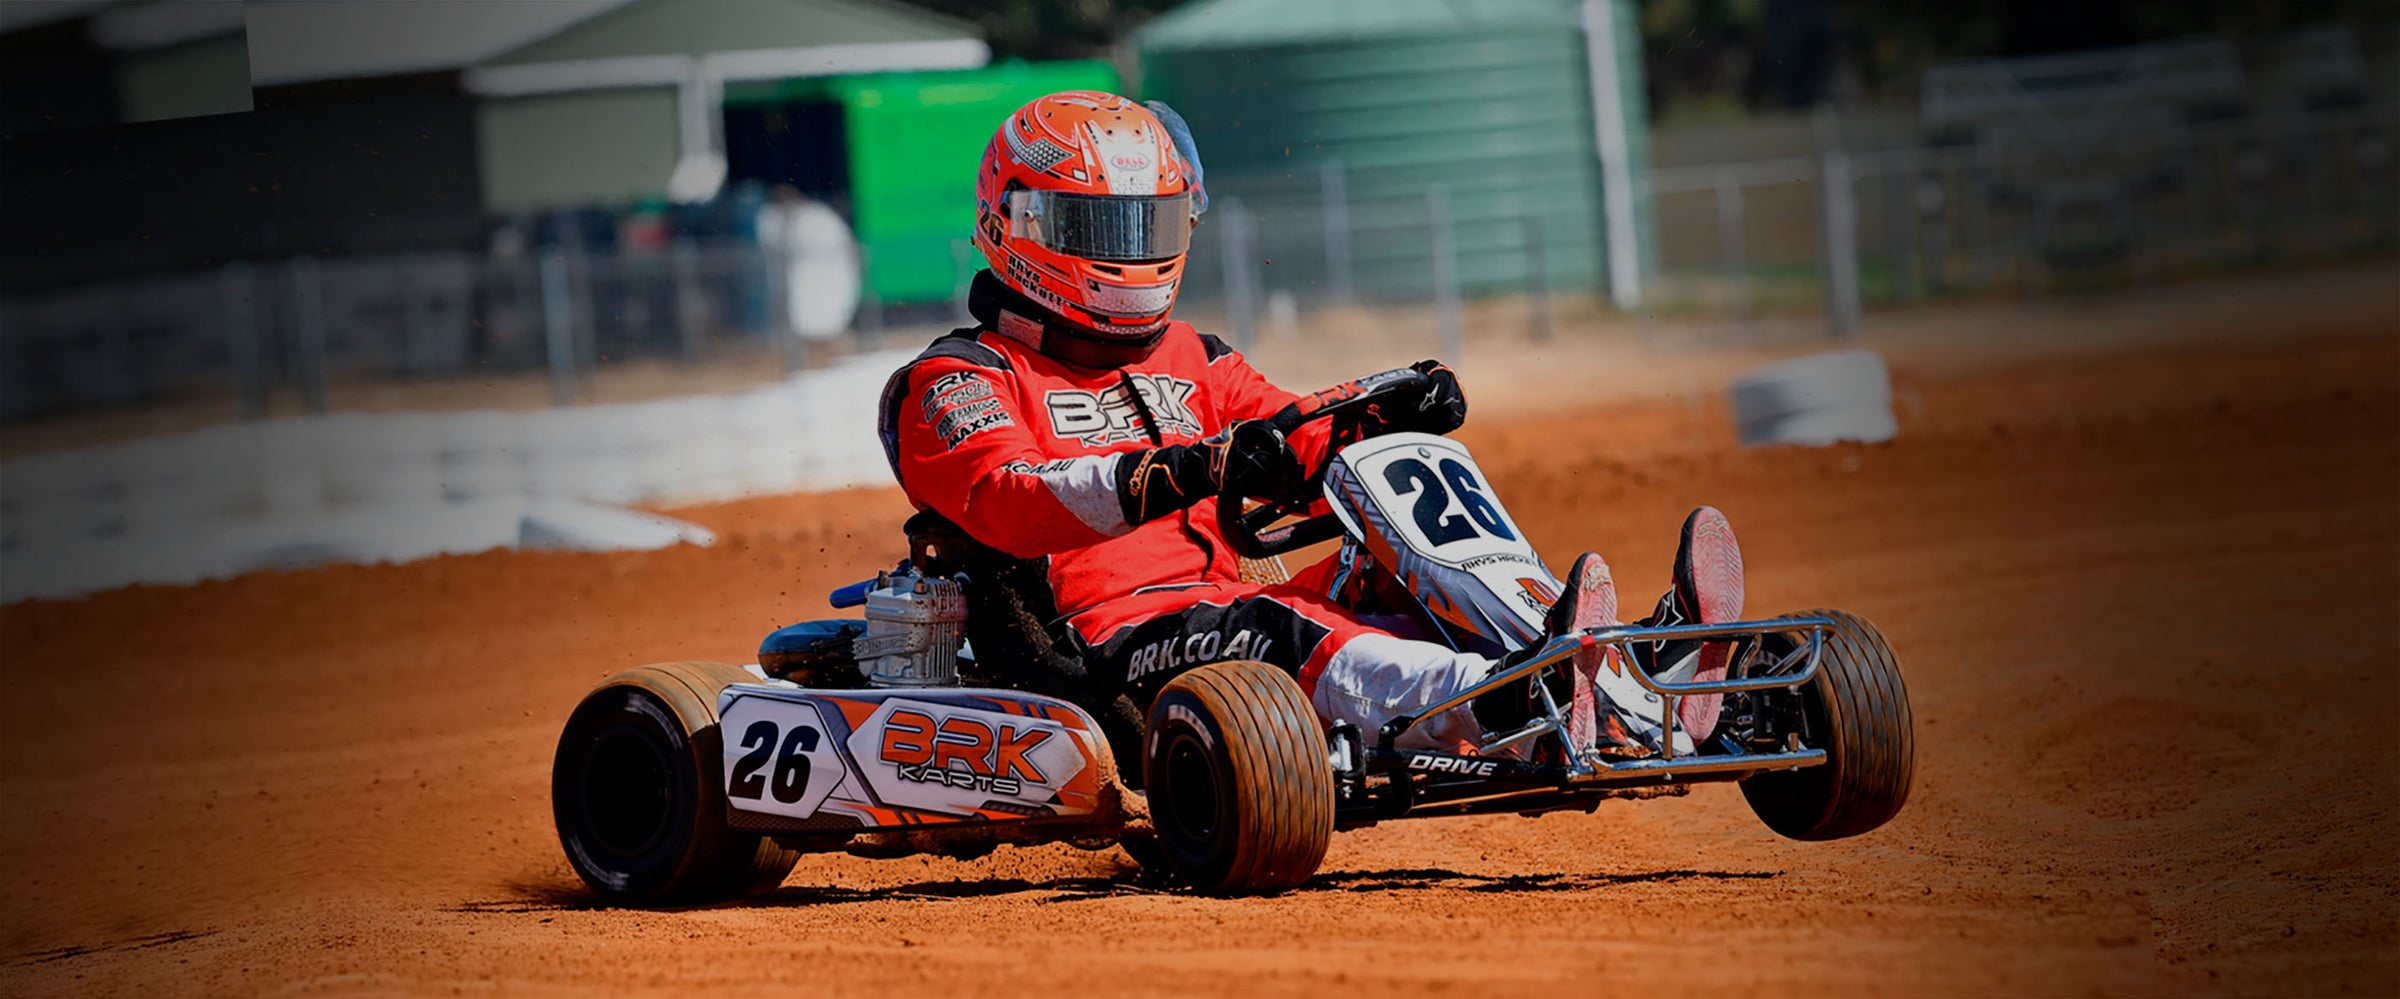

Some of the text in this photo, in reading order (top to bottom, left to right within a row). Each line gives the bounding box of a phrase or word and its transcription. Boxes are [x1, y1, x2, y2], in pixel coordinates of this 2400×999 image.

[979, 198, 1004, 247] 26
[948, 412, 1009, 451] MAXXIS
[1046, 375, 1201, 435] BRK
[1383, 457, 1516, 548] 26
[728, 720, 821, 804] 26
[879, 708, 1055, 787] BRK
[1408, 754, 1498, 776] DRIVE
[898, 763, 1021, 795] KARTS
